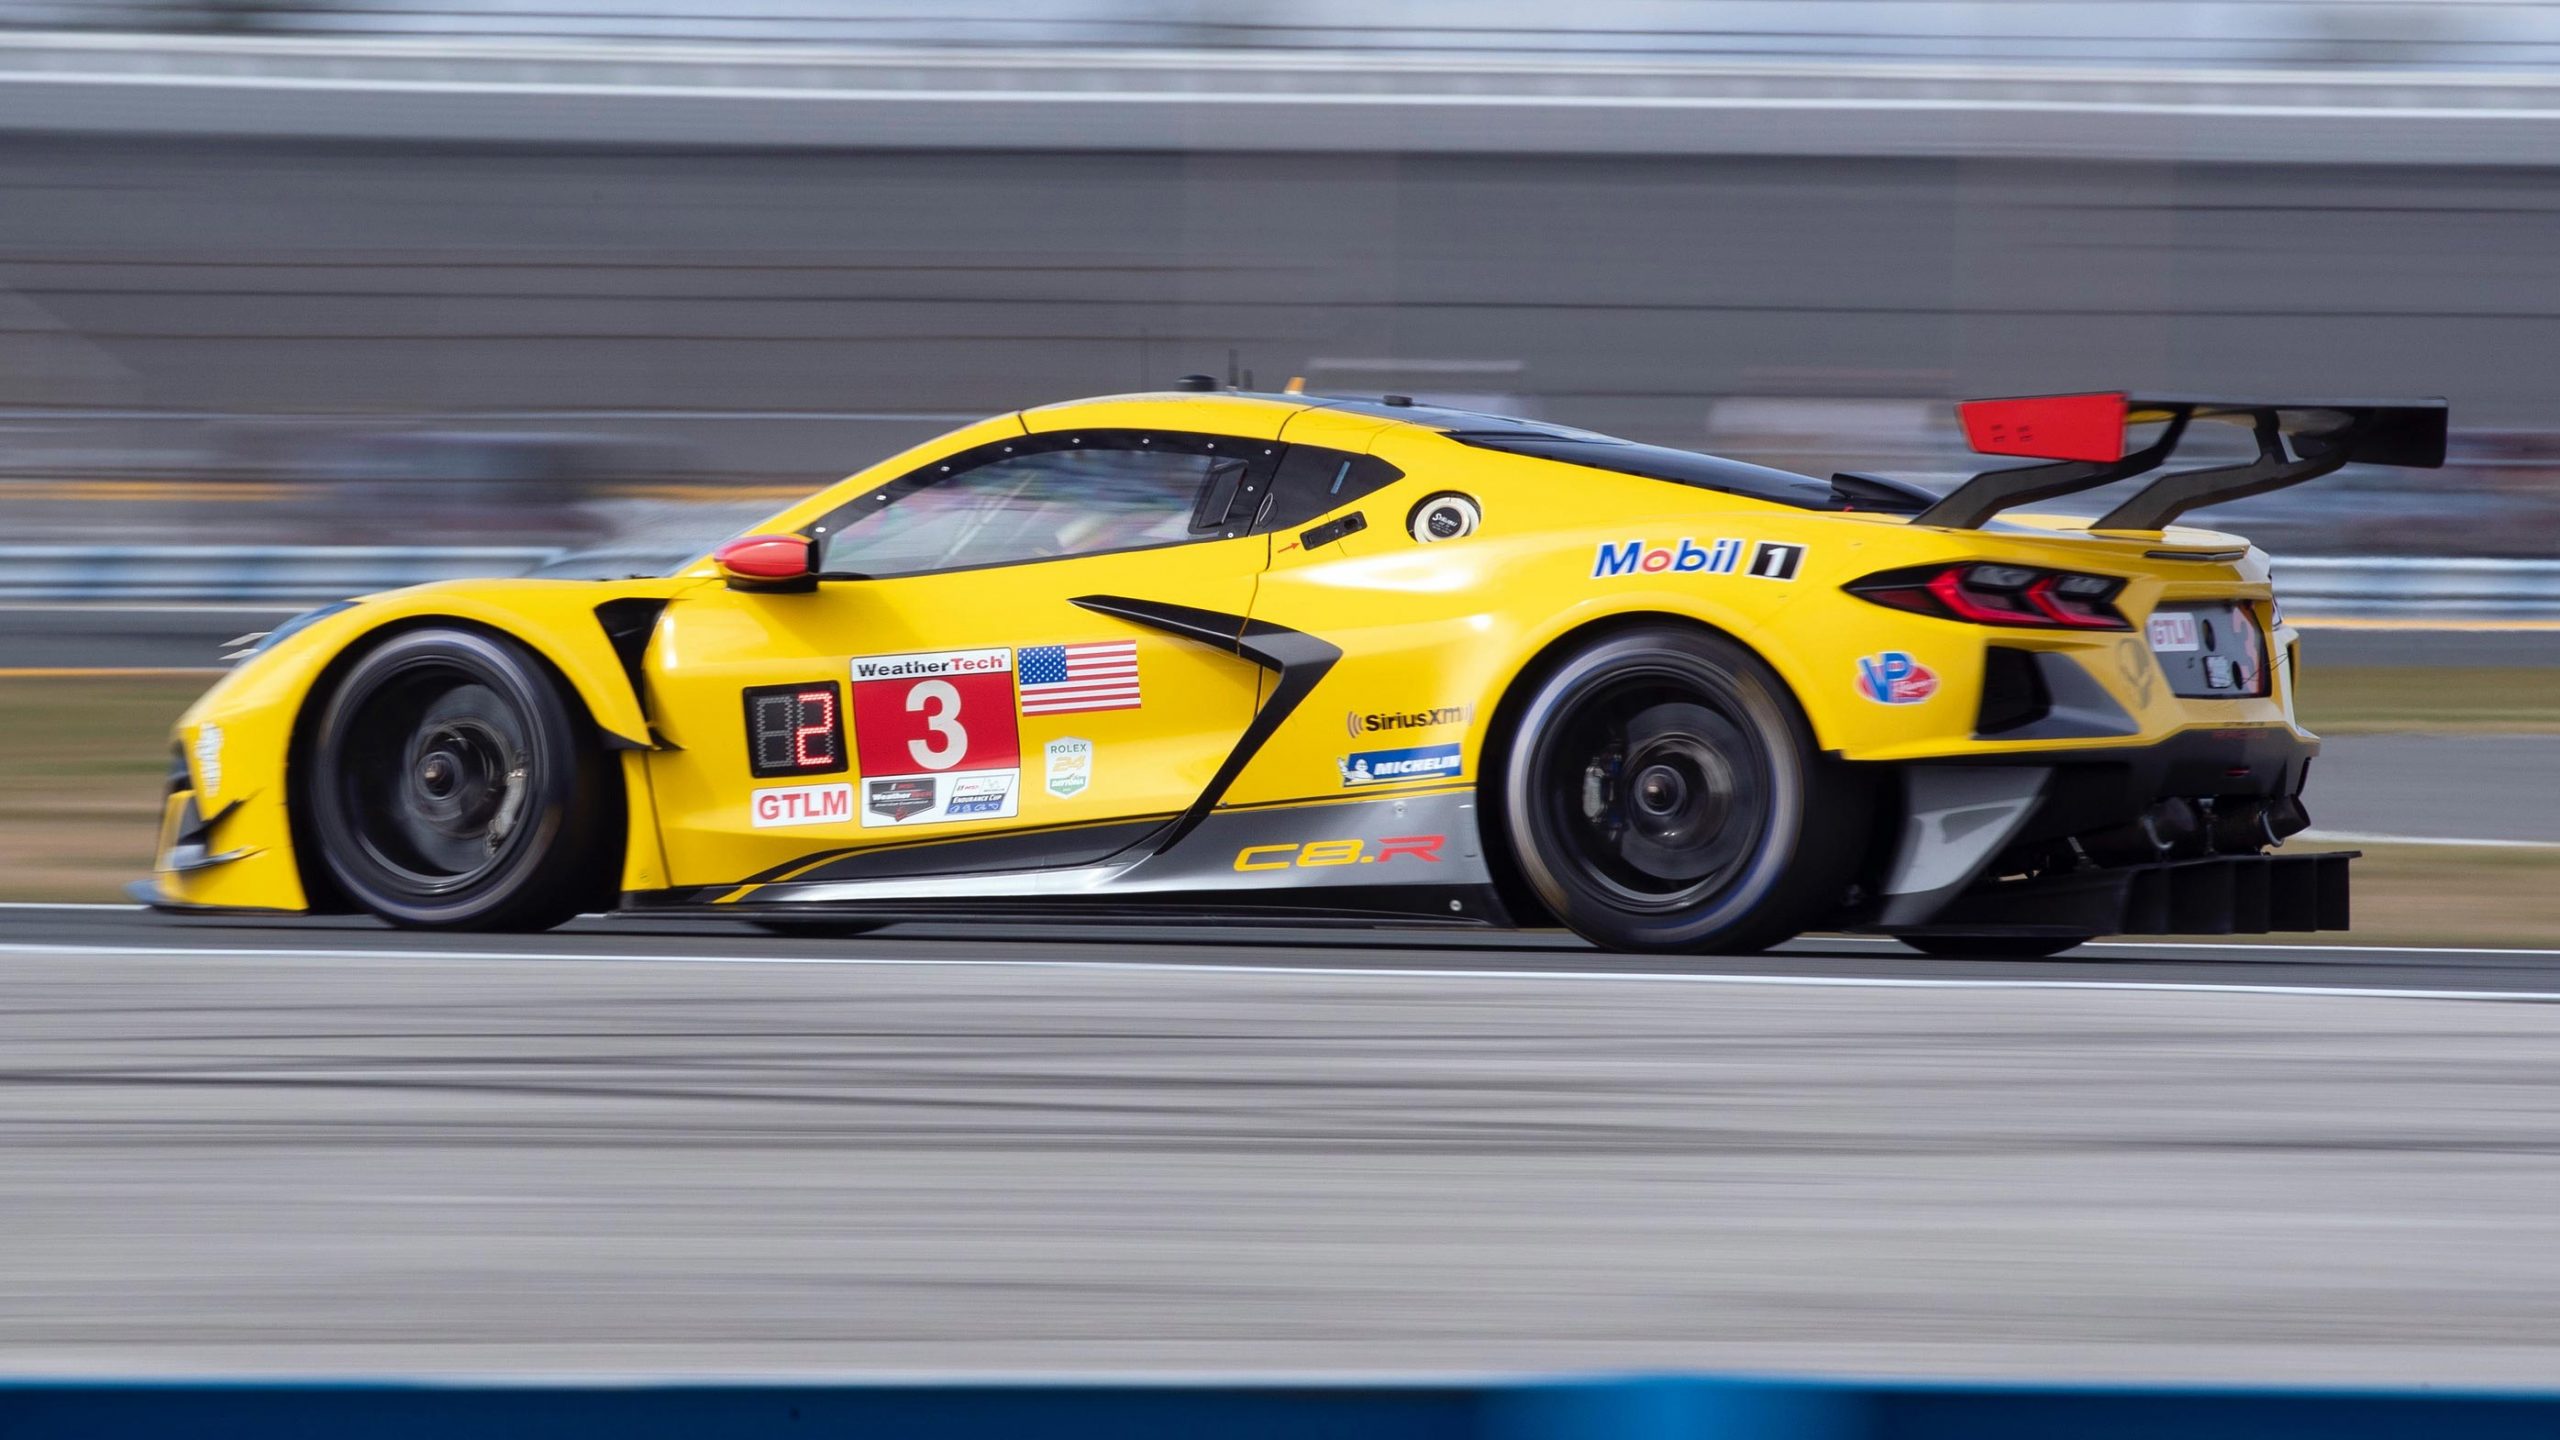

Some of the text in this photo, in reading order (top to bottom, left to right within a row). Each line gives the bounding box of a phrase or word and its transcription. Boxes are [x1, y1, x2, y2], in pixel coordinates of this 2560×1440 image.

[1594, 539, 1789, 578] Mobil 1
[2151, 619, 2195, 646] GTLM
[858, 655, 1004, 677] WeatherTech
[1858, 652, 1909, 702] VP
[797, 692, 833, 766] 2
[905, 679, 969, 770] 3
[1365, 706, 1461, 732] SiriusXM
[1050, 743, 1087, 754] ROLEX
[1052, 754, 1086, 772] 24
[1373, 754, 1461, 776] MICHELIN
[758, 790, 848, 820] GTLM
[1233, 834, 1446, 872] C8.R
